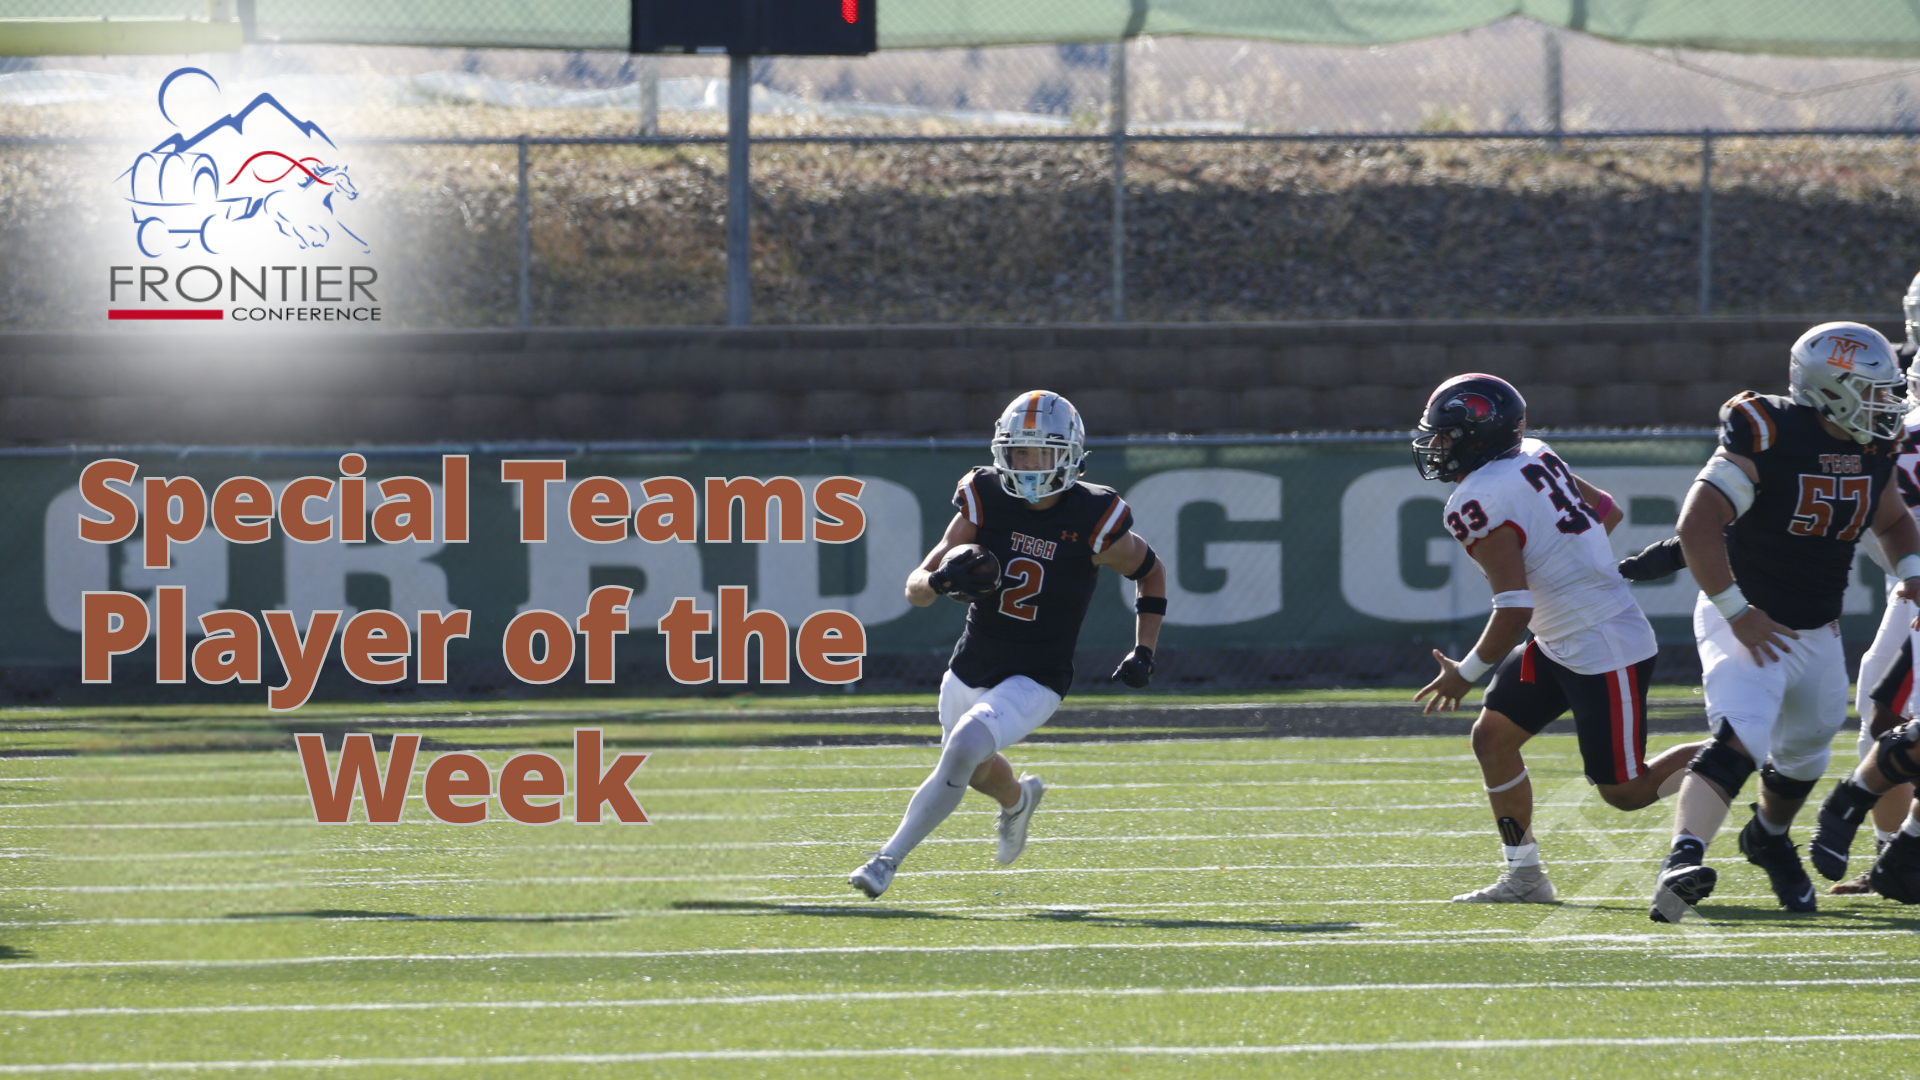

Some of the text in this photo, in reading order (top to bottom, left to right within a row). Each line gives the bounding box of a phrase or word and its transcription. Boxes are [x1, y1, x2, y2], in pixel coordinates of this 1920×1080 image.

[1818, 454, 1862, 474] TECH
[1447, 499, 1489, 542] 33
[1786, 474, 1872, 541] 57
[1012, 531, 1057, 560] TECH
[999, 557, 1044, 621] 2
